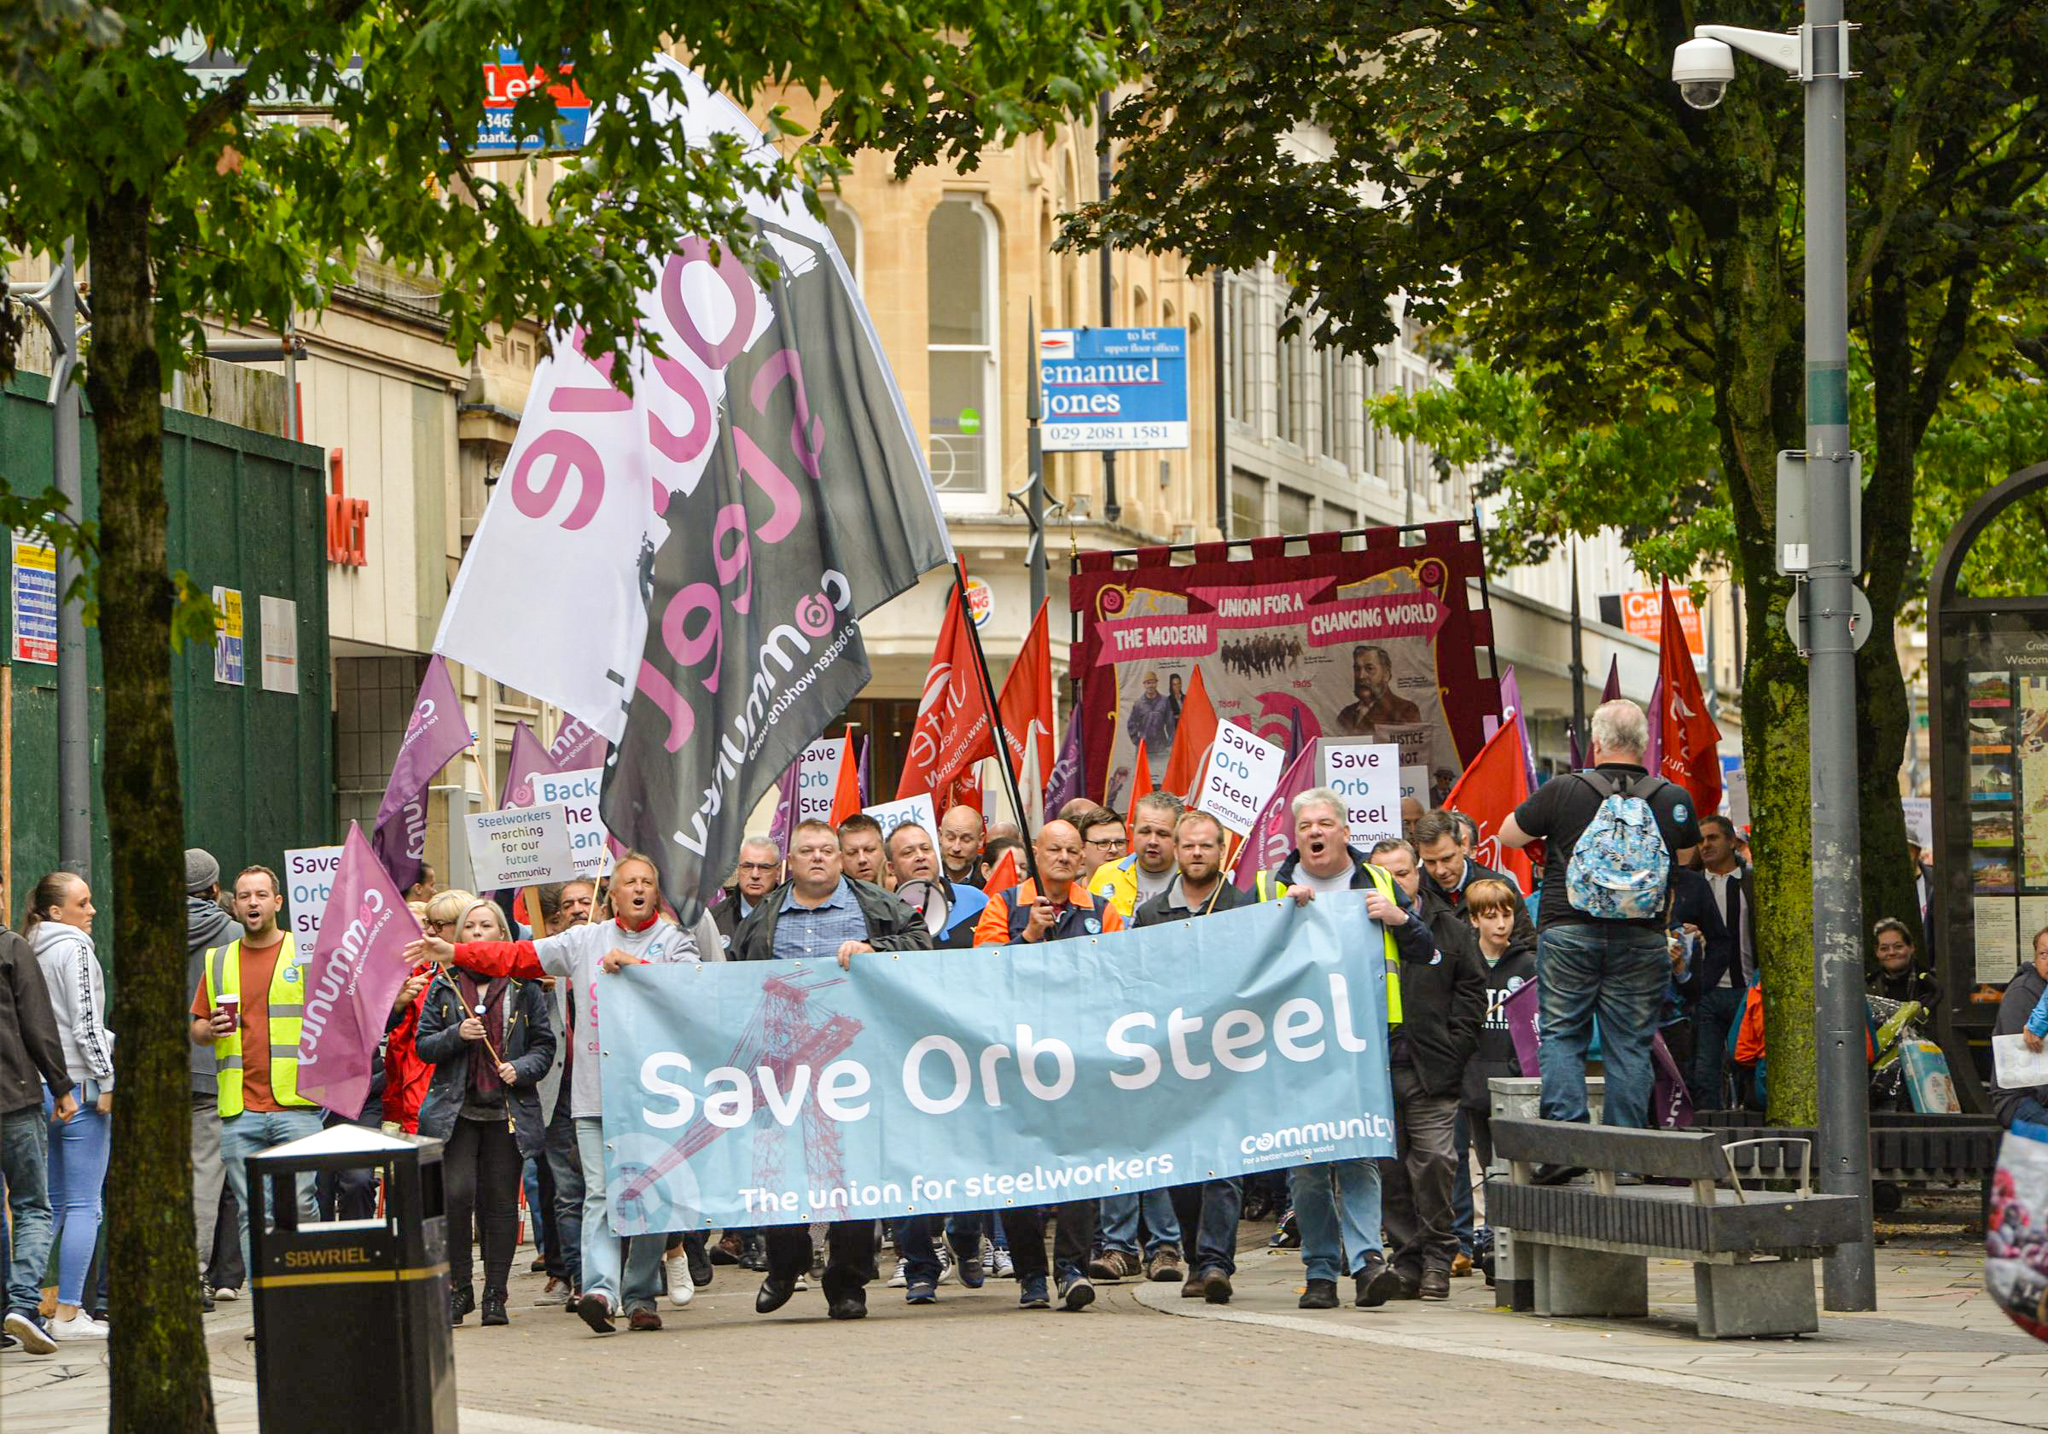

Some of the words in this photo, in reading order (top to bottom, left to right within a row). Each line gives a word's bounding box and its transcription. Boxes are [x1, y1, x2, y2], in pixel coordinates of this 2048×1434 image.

[488, 71, 541, 102] Let
[1127, 330, 1139, 341] to
[1141, 329, 1157, 341] let
[1041, 358, 1160, 383] emanuel
[1041, 389, 1121, 422] jones
[1050, 427, 1080, 440] 029
[1086, 426, 1124, 440] 2081
[1132, 425, 1169, 439] 1581
[1218, 597, 1262, 617] UNION
[1264, 593, 1293, 615] FOR
[1293, 592, 1304, 611] A
[1311, 607, 1382, 636] CHANGING
[1384, 603, 1438, 626] WORLD
[1113, 628, 1144, 651] THE
[1146, 624, 1207, 647] MODERN
[1222, 728, 1266, 761] Save
[1215, 751, 1249, 780] Orb
[1331, 751, 1379, 768] Save
[543, 778, 599, 802] Back
[1210, 776, 1259, 813] Steel
[1331, 778, 1369, 795] Orb
[477, 810, 552, 828] Steelworkers
[565, 806, 593, 825] he
[1347, 806, 1388, 823] teel
[490, 826, 544, 841] marching
[501, 843, 520, 854] for
[521, 840, 540, 850] our
[292, 856, 341, 874] Save
[505, 853, 539, 866] future
[498, 866, 552, 882] community
[294, 886, 331, 903] Orb
[640, 1050, 872, 1129] Save
[902, 1023, 1076, 1115] Orb
[1105, 972, 1367, 1090] Steel
[1240, 1111, 1395, 1154] community
[738, 1187, 799, 1213] The
[808, 1180, 902, 1209] union
[911, 1174, 957, 1201] for
[964, 1152, 1174, 1198] steelworkers
[285, 1247, 370, 1267] SBWRIEL
